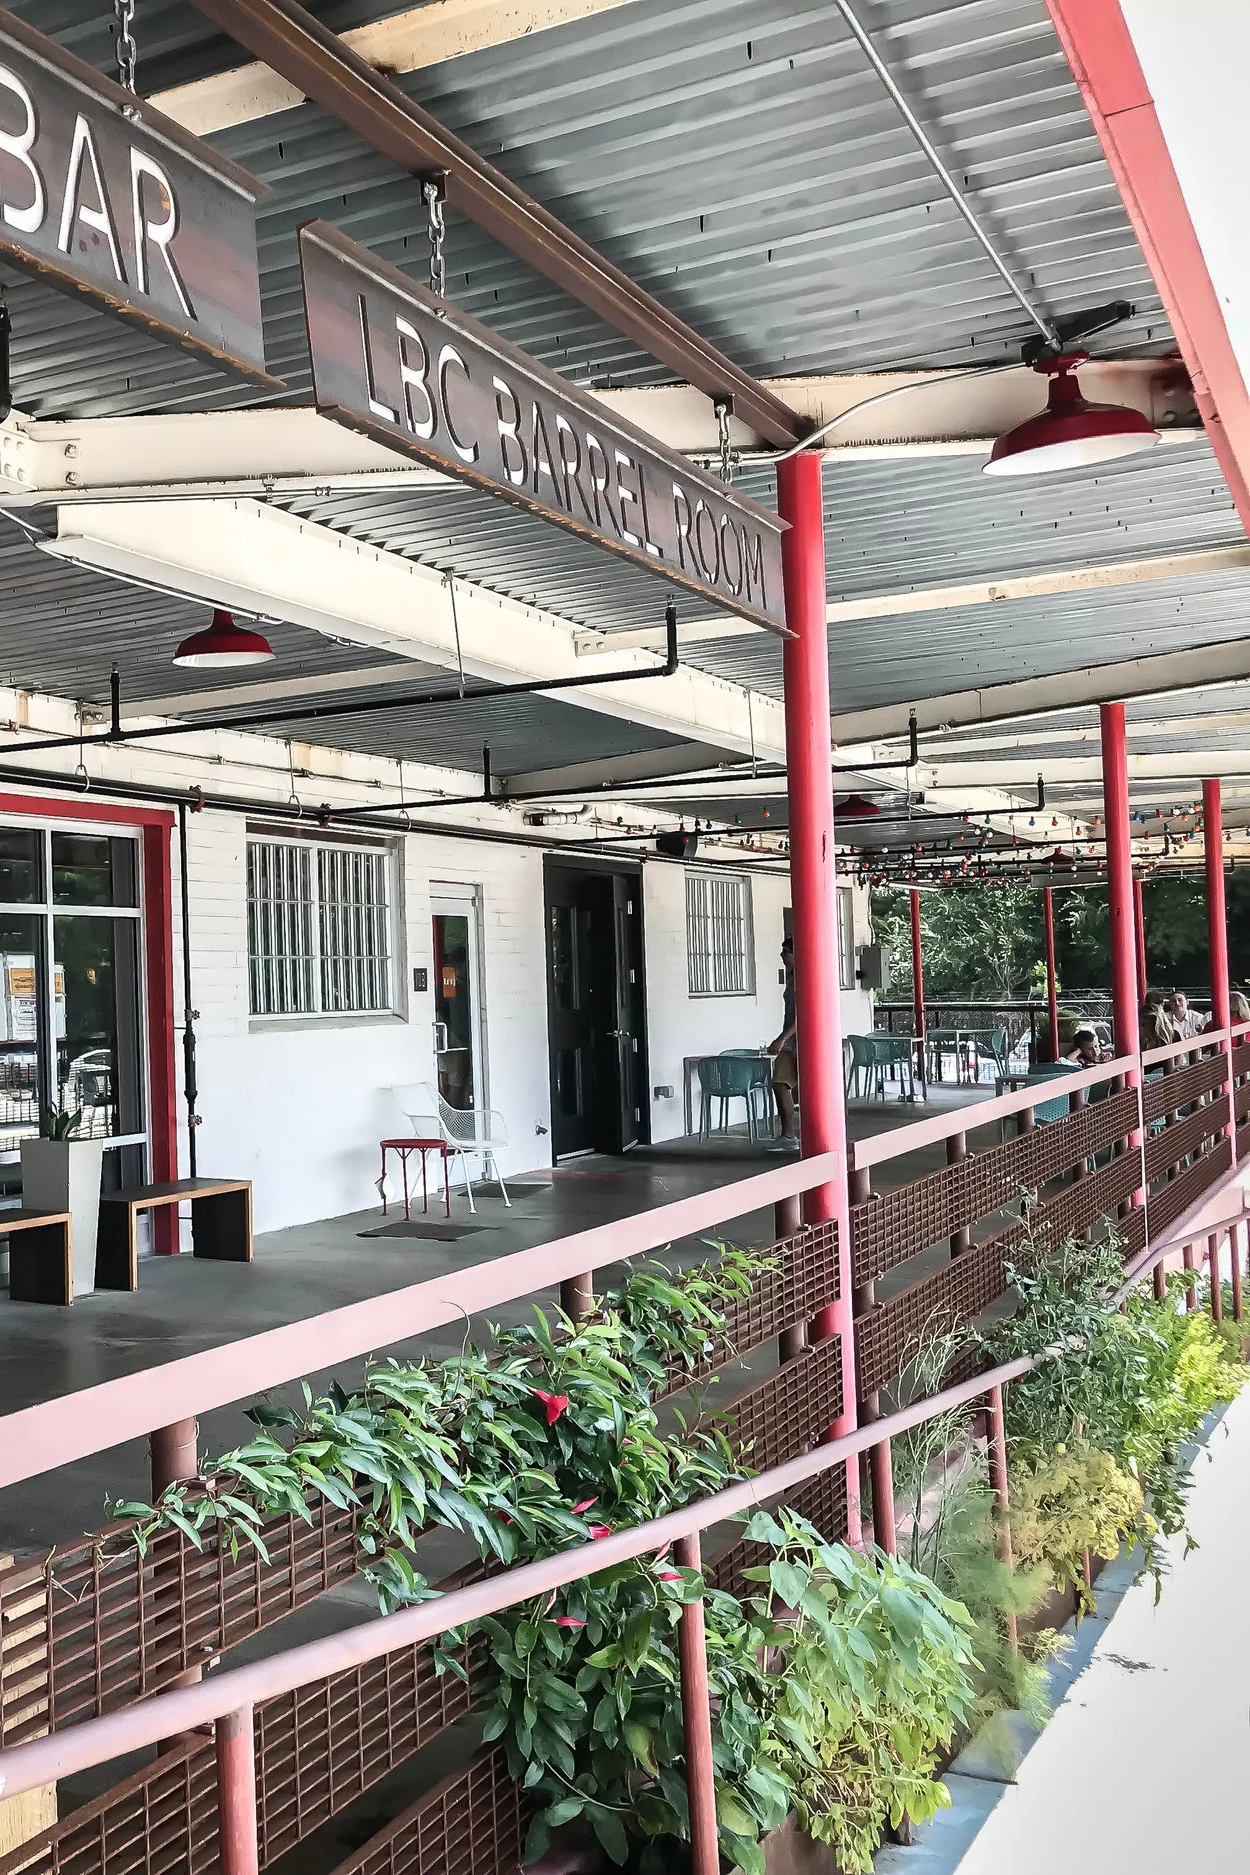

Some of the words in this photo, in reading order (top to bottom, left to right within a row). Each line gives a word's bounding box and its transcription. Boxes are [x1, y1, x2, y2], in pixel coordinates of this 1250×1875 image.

[358, 292, 480, 463] LBC
[493, 375, 663, 557] BARREL
[673, 483, 768, 610] ROOM
